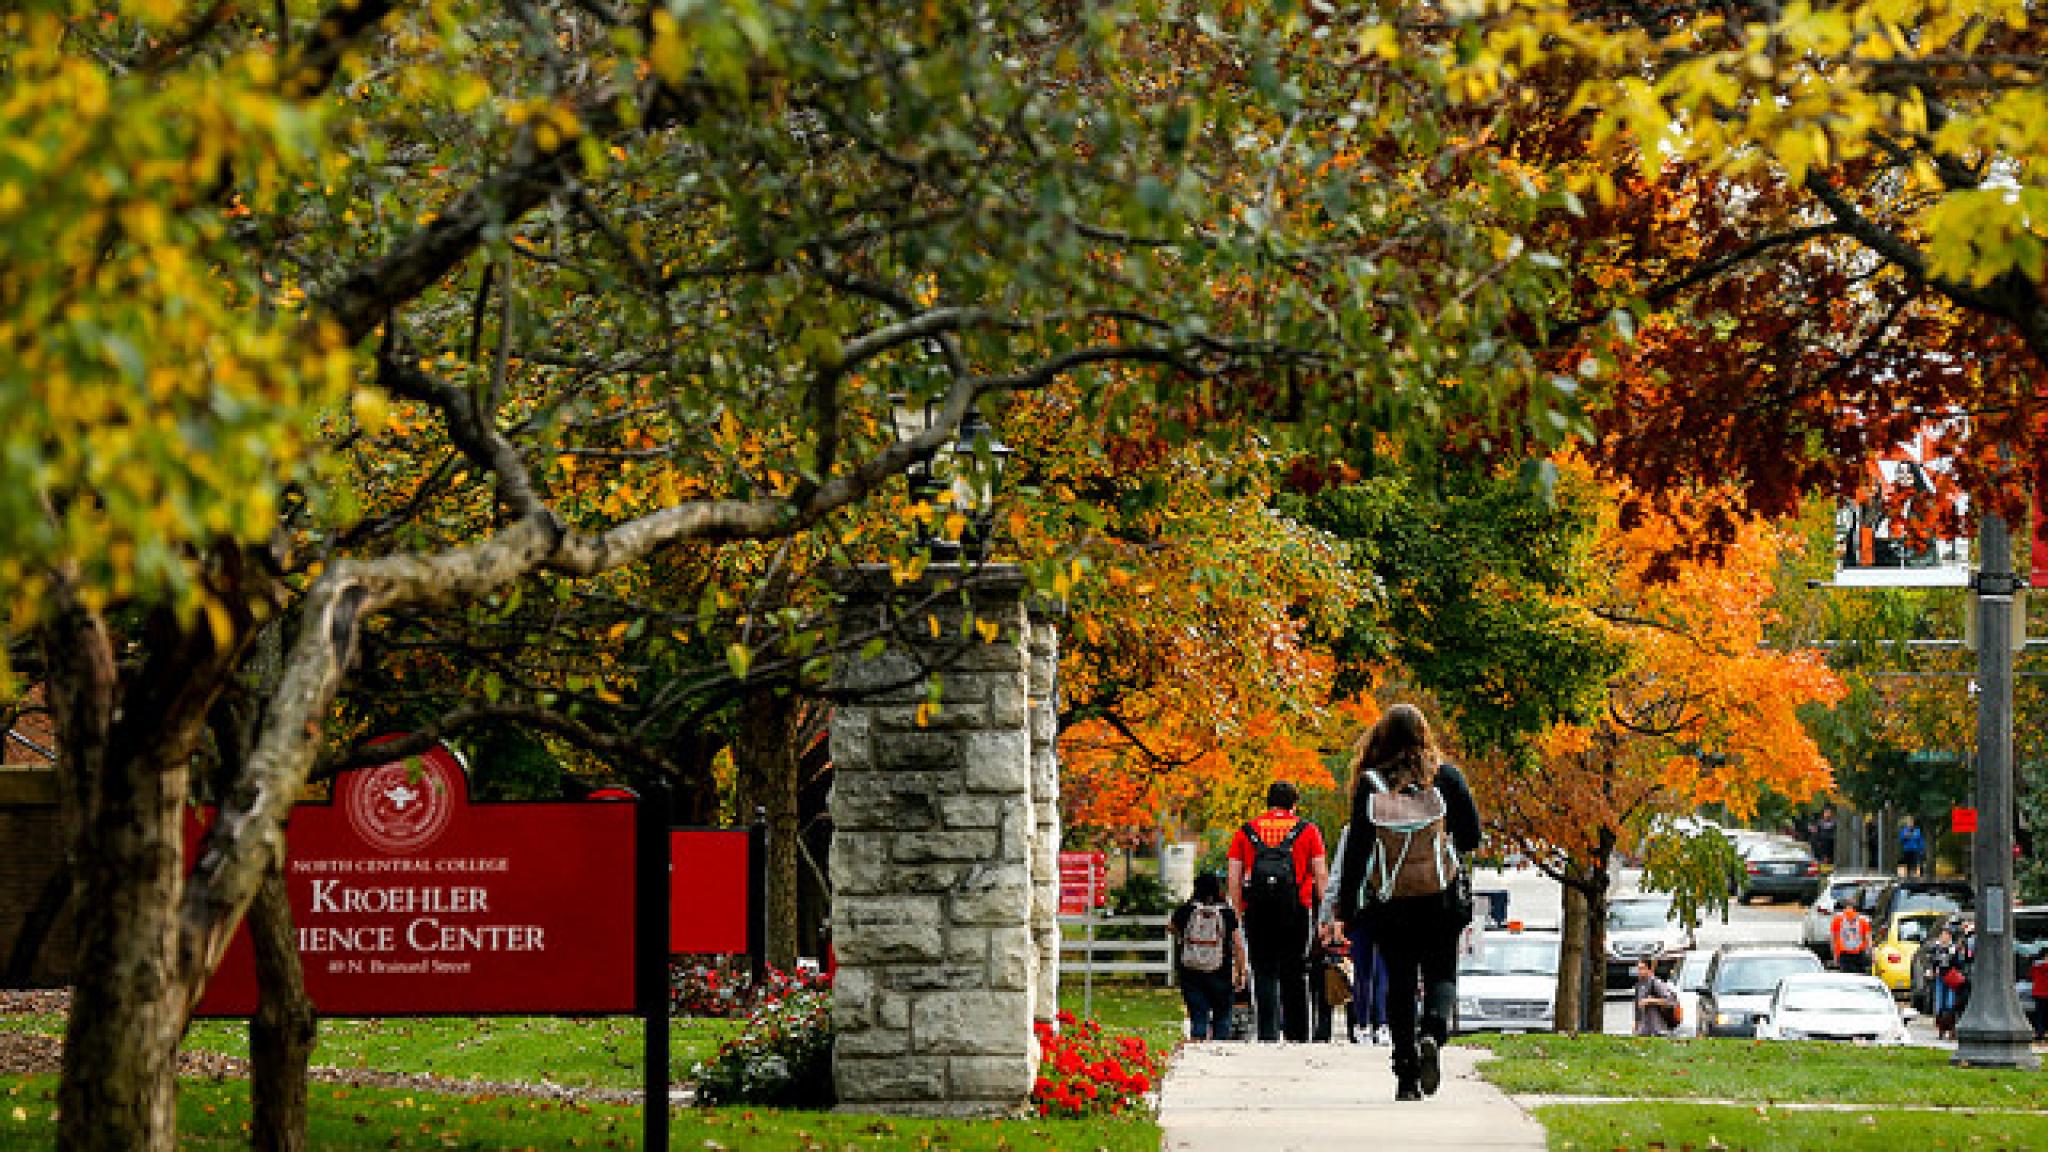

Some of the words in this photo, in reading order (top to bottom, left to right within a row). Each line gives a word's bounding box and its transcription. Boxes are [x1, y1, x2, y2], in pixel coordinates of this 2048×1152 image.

[292, 858, 352, 873] NORTH
[355, 858, 433, 873] CENTRAL
[435, 858, 510, 873] COLLEGE
[310, 879, 490, 913] KROEHLER
[297, 926, 395, 951] IENCE
[406, 917, 545, 951] CENTER
[431, 959, 472, 974] Street
